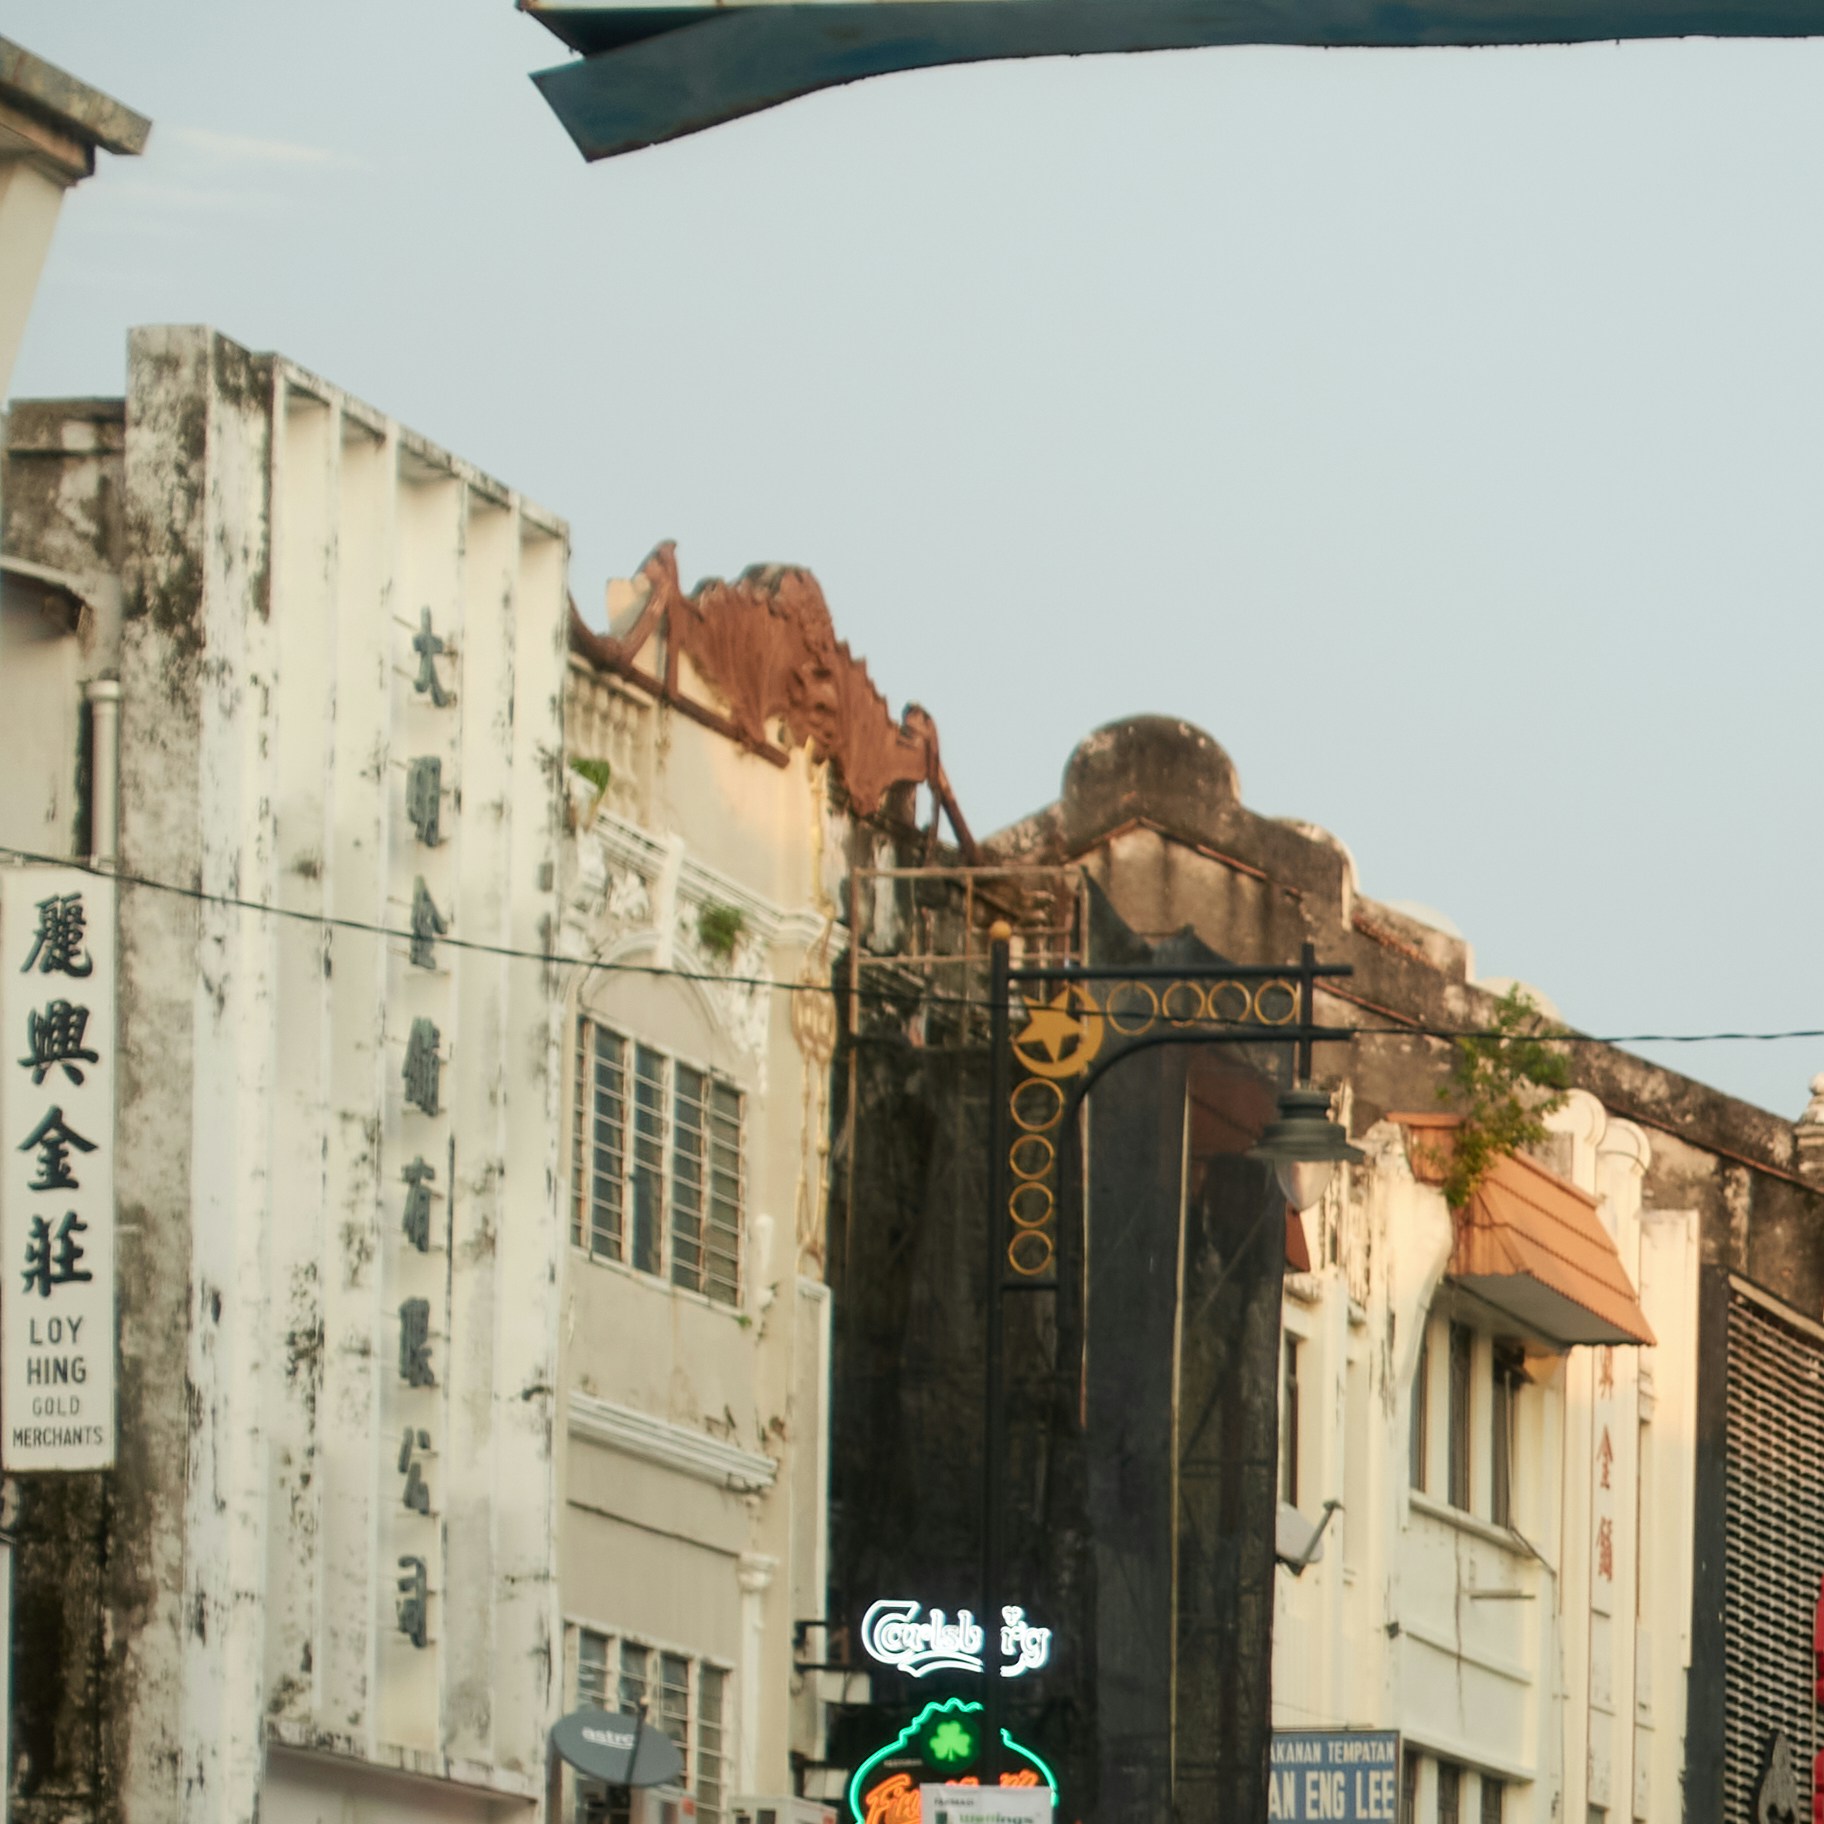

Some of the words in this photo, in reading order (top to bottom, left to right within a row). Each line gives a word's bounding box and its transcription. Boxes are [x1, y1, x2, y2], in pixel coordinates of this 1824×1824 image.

[30, 1316, 84, 1347] LOY
[27, 1356, 87, 1385] HING
[32, 1397, 81, 1417] GOLD
[12, 1424, 104, 1448] MERCHANTS
[861, 1599, 1051, 1678] Carlsbrg
[1270, 1741, 1322, 1764] AKANAN
[1327, 1740, 1394, 1764] TEMPATAN
[1268, 1770, 1296, 1820] AN
[1305, 1770, 1345, 1820] ENG
[1355, 1770, 1394, 1820] LEE
